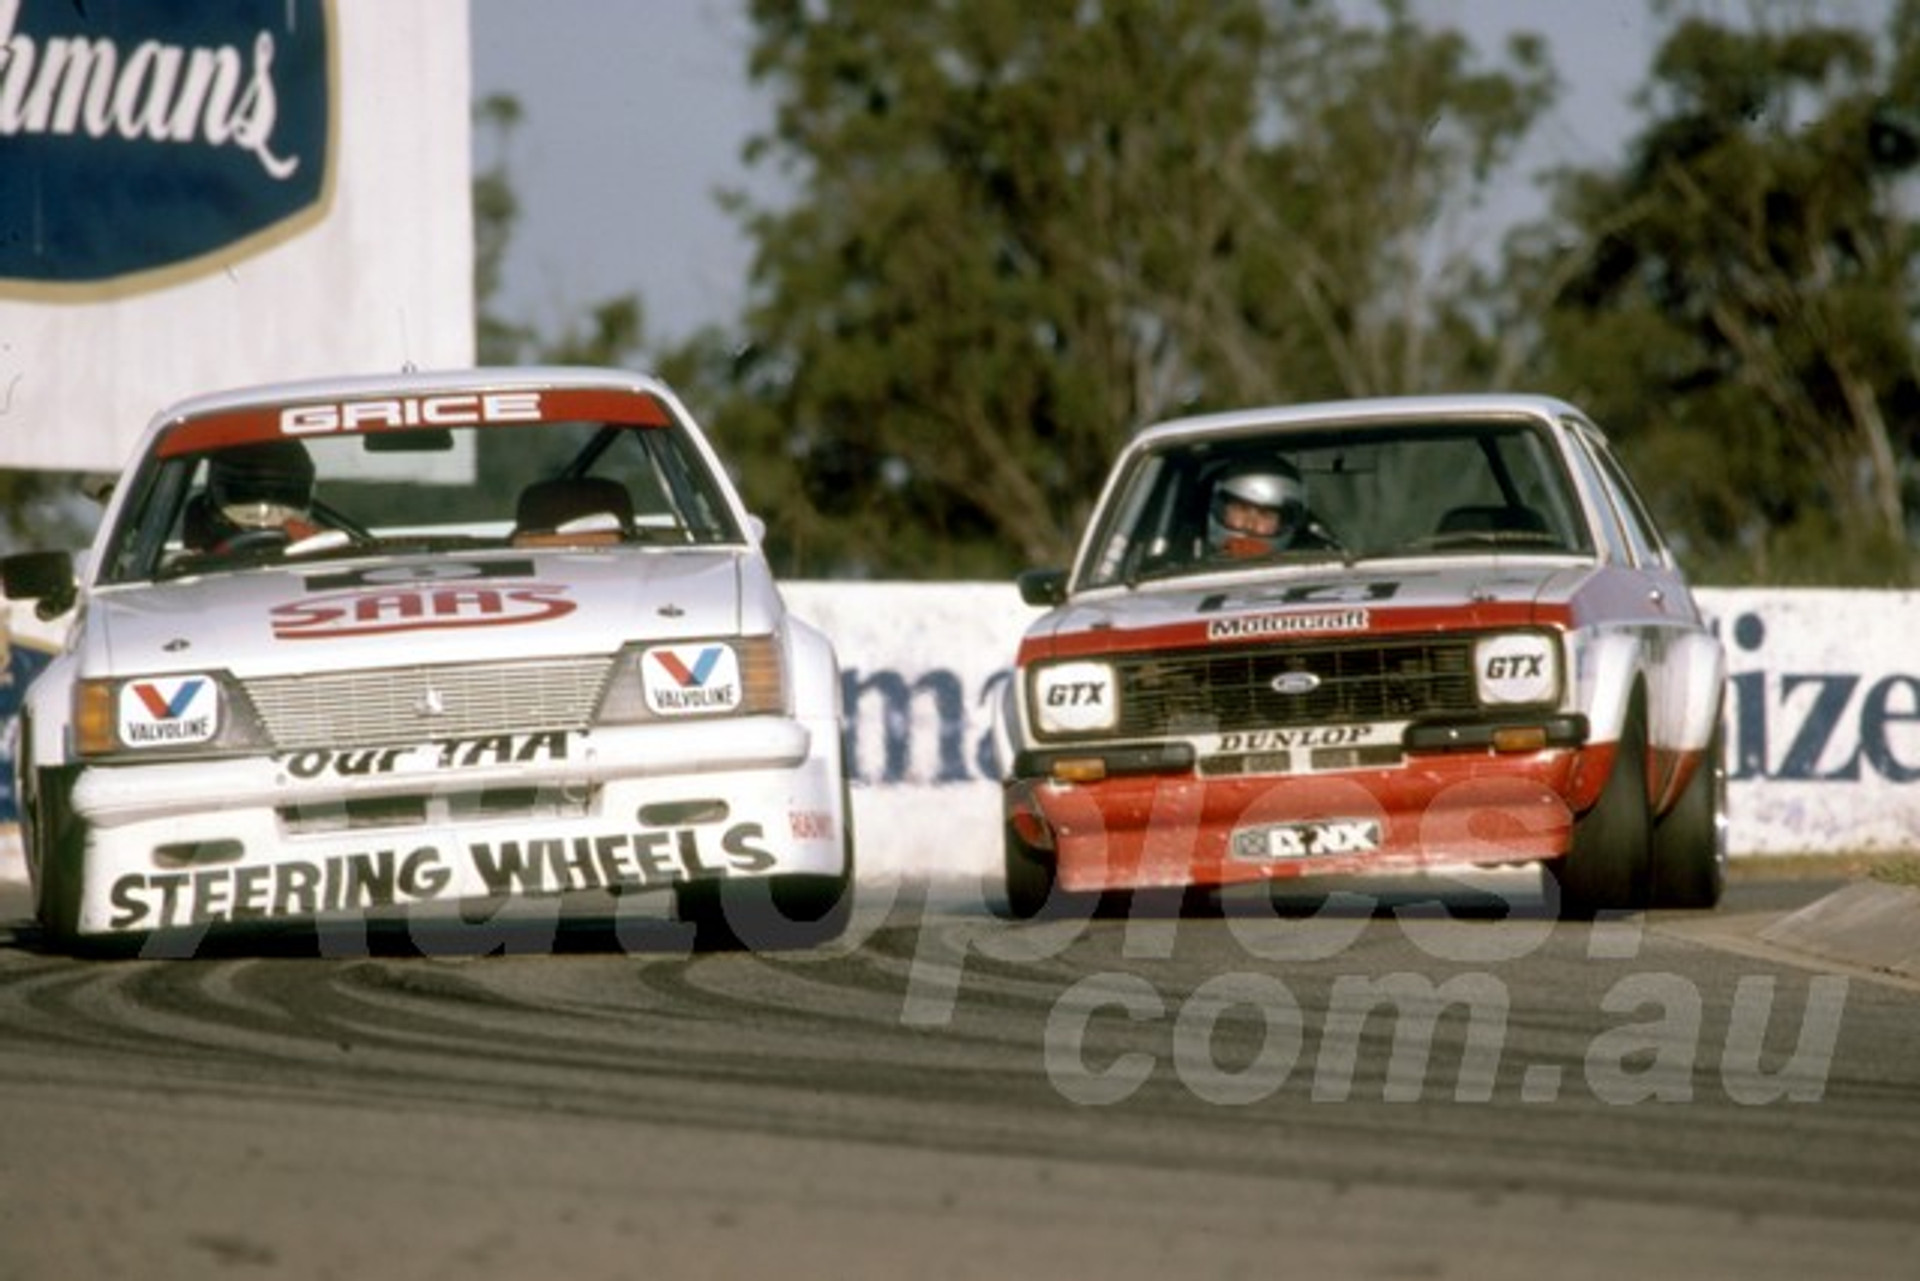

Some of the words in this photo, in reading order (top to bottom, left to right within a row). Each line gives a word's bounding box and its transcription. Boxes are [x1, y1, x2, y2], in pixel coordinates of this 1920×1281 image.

[280, 391, 542, 435] GRICE
[269, 585, 577, 640] SAAS
[1210, 610, 1366, 636] Motorcraft
[1486, 654, 1544, 679] GTX
[654, 684, 734, 708] VALVOLINE
[1047, 682, 1105, 706] GTX
[128, 718, 209, 741] VALVOLINE
[1220, 727, 1373, 751] DUNLOP
[109, 845, 452, 929] STEERING
[470, 821, 778, 898] WHEELS
